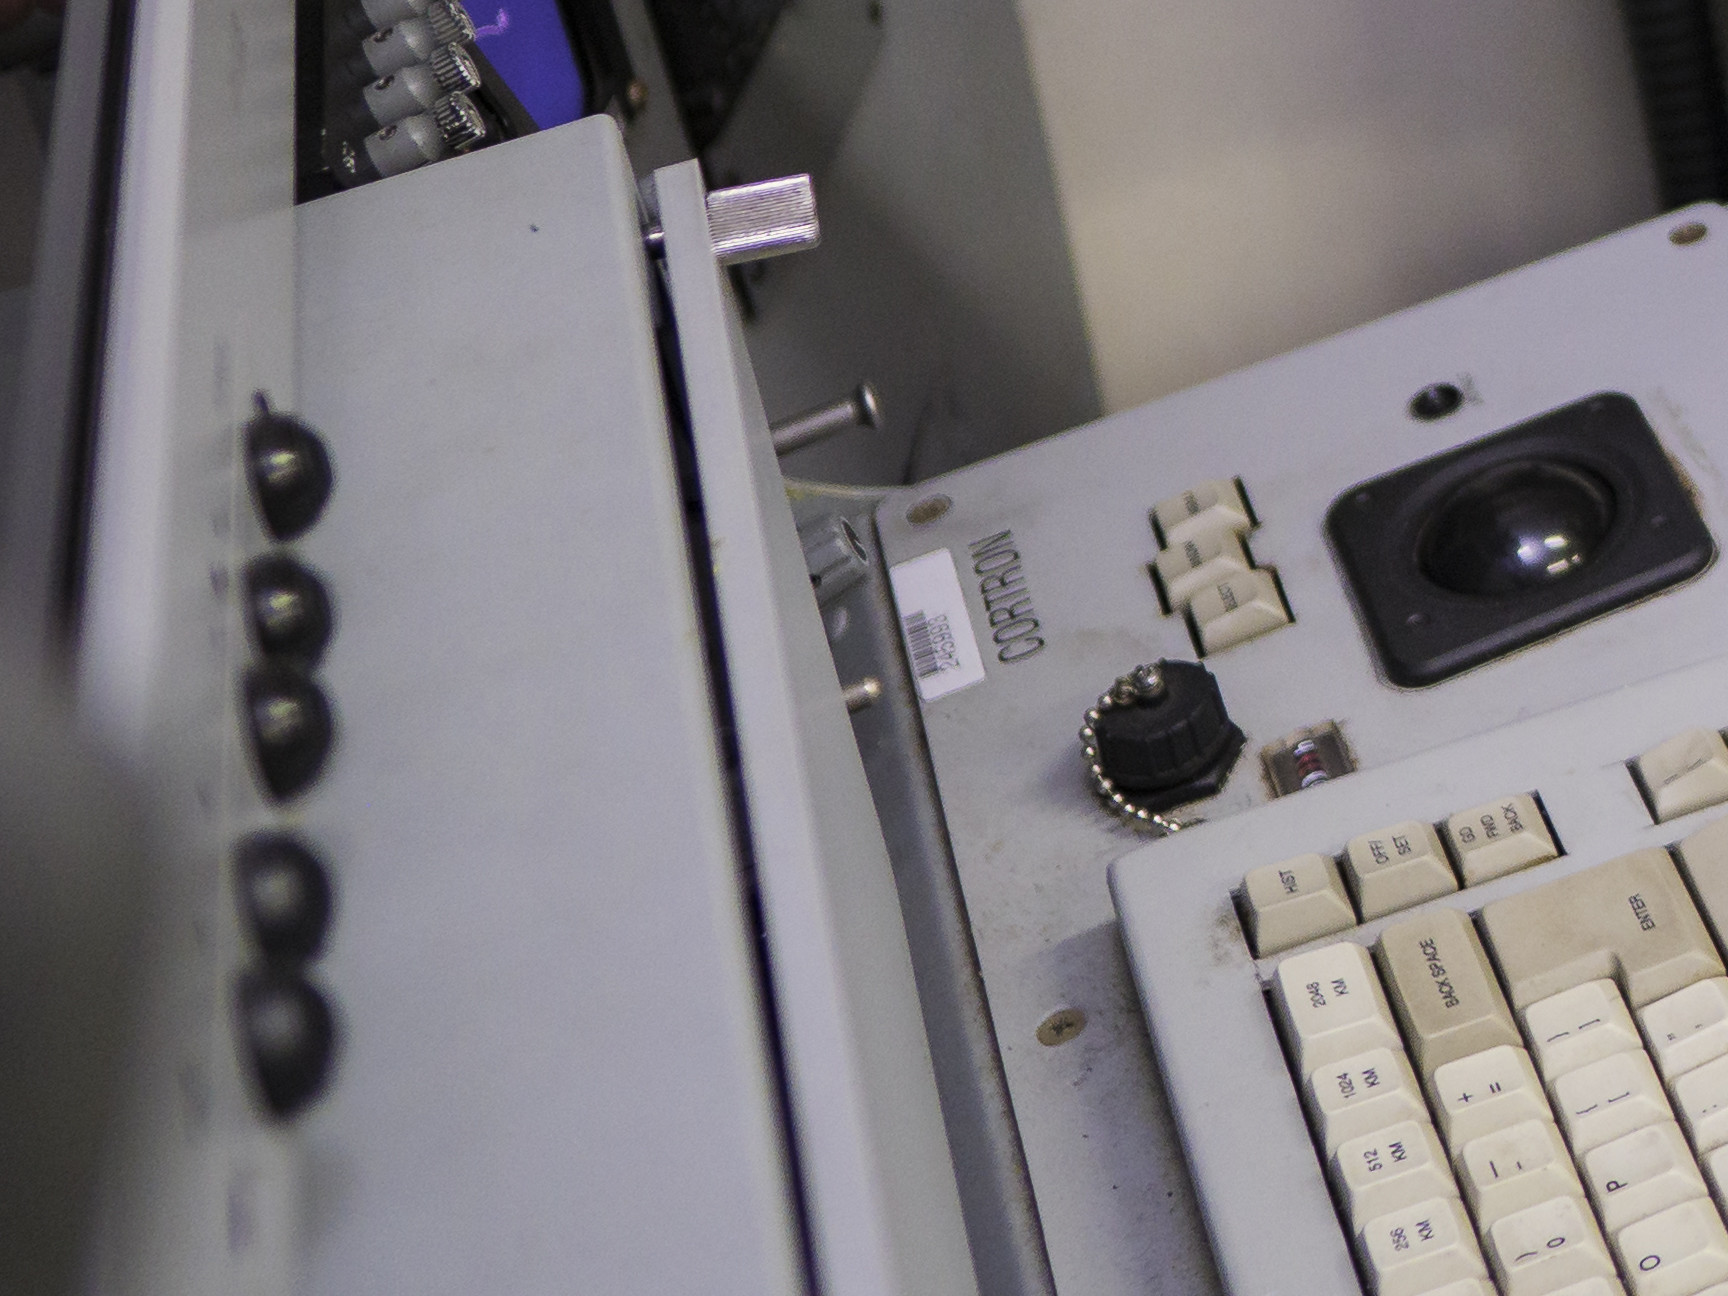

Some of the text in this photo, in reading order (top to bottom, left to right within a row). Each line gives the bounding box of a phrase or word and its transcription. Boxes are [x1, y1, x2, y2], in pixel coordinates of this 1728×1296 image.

[967, 529, 1046, 663] CORTRON
[1501, 802, 1526, 834] BACK
[1392, 834, 1412, 856] SET
[1278, 869, 1299, 895] HIST
[1627, 892, 1657, 932] ENTER
[1418, 937, 1461, 1009] BACK SPACE
[1305, 981, 1327, 1010] 2048
[1331, 977, 1350, 998] KM
[1336, 1072, 1357, 1100] 1024
[1361, 1067, 1381, 1089] KM
[1363, 1147, 1384, 1174] 512
[1388, 1140, 1408, 1164] KM
[1605, 1179, 1629, 1194] P
[1389, 1226, 1410, 1253] 256
[1415, 1218, 1435, 1243] KM
[1638, 1254, 1661, 1272] O
